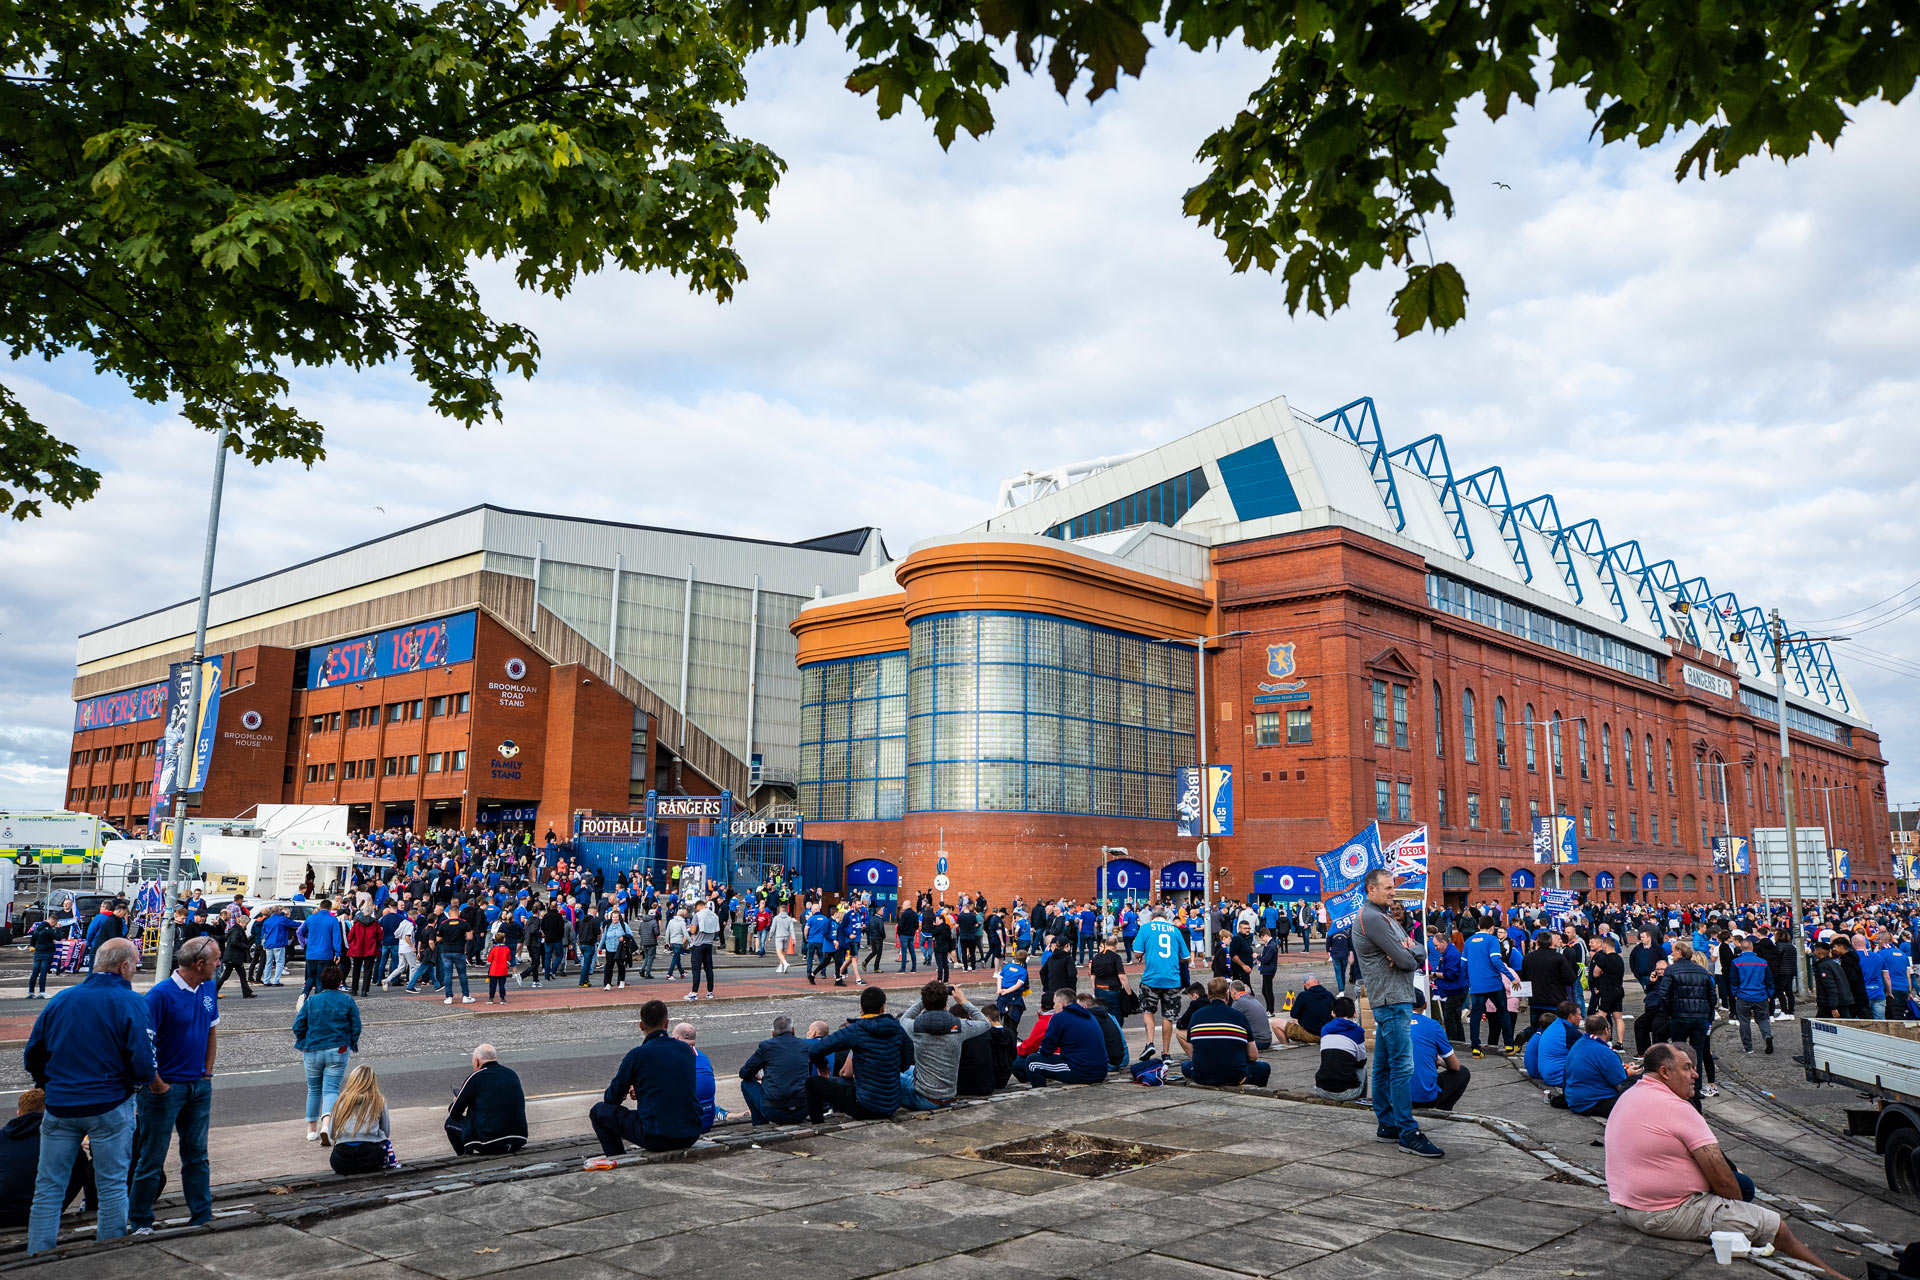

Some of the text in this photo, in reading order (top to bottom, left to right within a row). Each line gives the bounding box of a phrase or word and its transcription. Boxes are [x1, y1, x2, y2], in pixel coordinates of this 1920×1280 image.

[1687, 667, 1716, 691] RANGERS
[488, 682, 537, 693] BROOMLOAN
[501, 691, 524, 700] ROAD
[499, 699, 525, 707] STAND
[224, 732, 273, 743] BROOMLOAN
[199, 738, 209, 753] 55
[235, 739, 261, 748] HOUSE
[490, 759, 523, 770] FAMILY
[491, 769, 522, 780] STAND
[658, 801, 720, 815] RANGERS
[1216, 807, 1227, 816] 55
[582, 820, 646, 834] FOOTBALL
[731, 821, 768, 835] CLUB
[1541, 819, 1551, 851] IBROX
[1150, 923, 1175, 933] STEIN
[1158, 933, 1171, 959] 9
